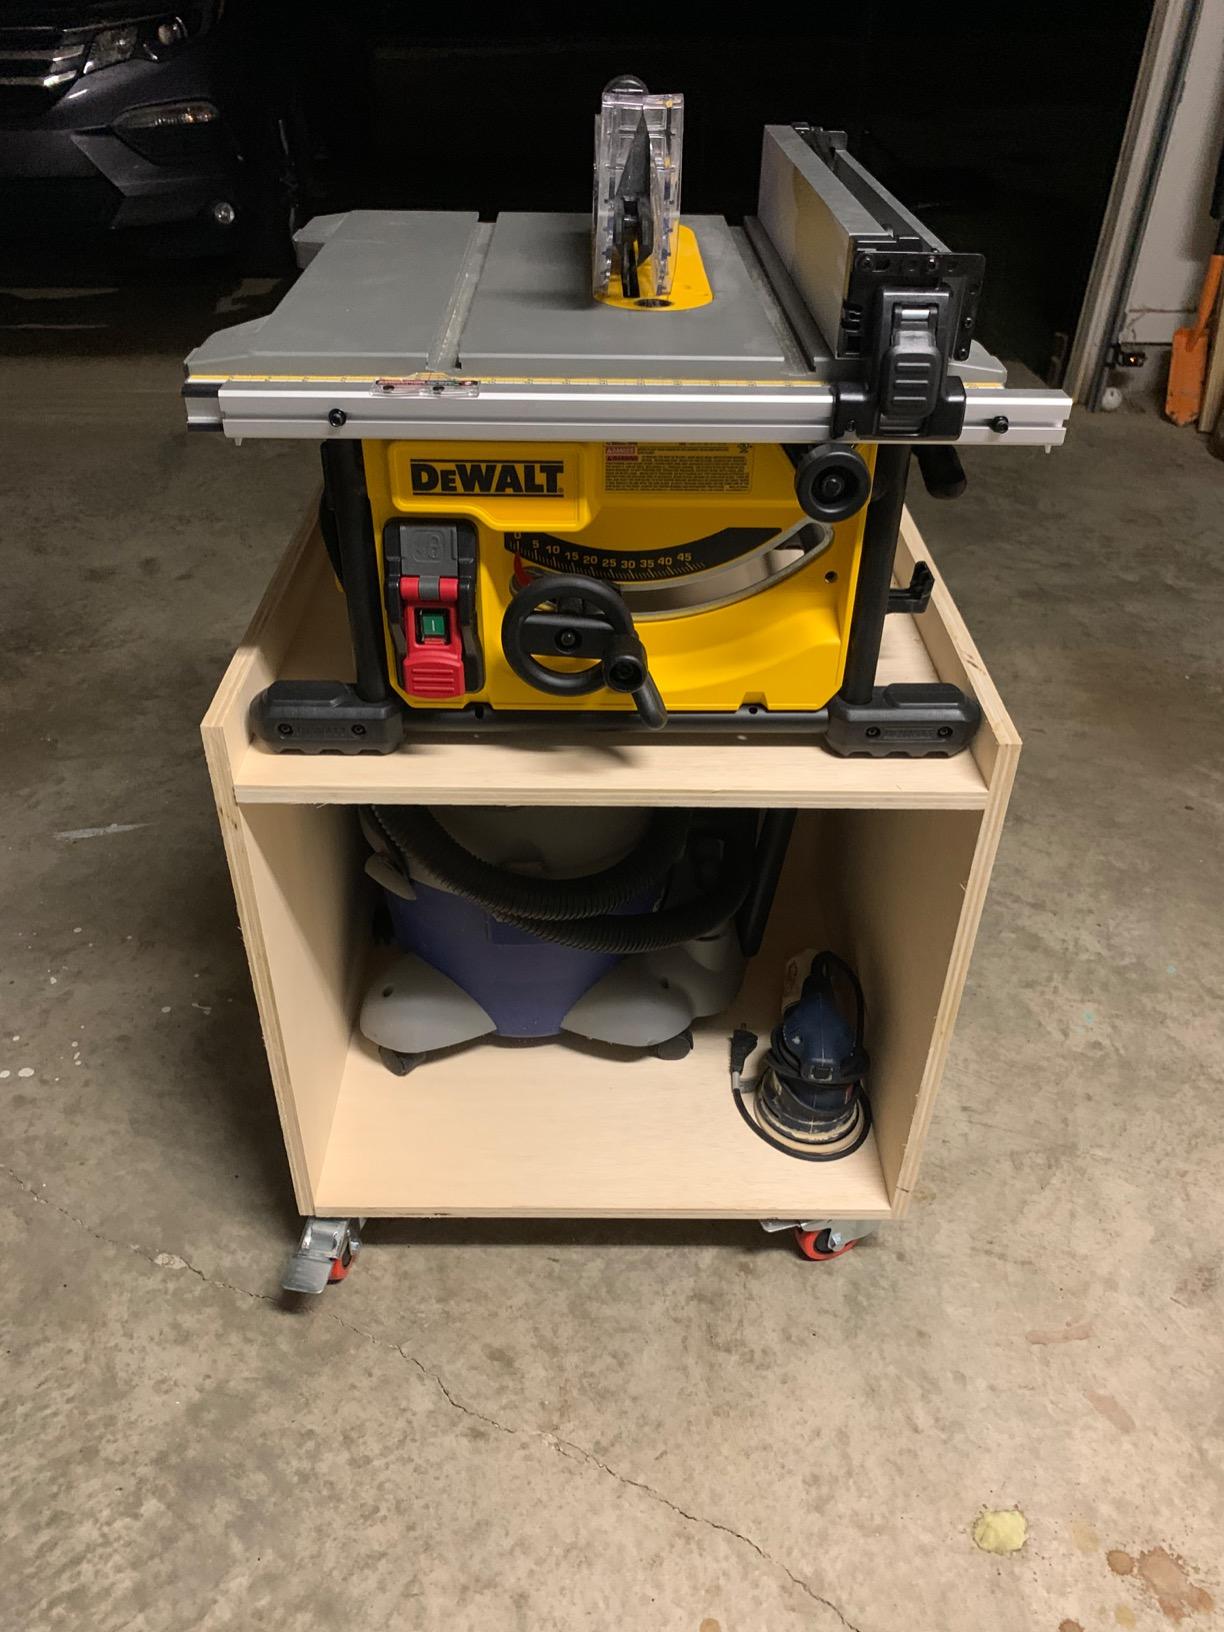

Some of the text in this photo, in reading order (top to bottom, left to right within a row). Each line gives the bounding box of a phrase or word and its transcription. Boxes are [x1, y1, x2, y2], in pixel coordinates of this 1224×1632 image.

[532, 540, 540, 549] 5
[546, 545, 560, 554] 10
[565, 552, 579, 561] 15
[583, 556, 598, 565] 20
[602, 559, 617, 568] 25
[621, 561, 636, 569] 30
[640, 559, 655, 568] 35
[658, 556, 673, 566] 40
[677, 552, 692, 561] 45
